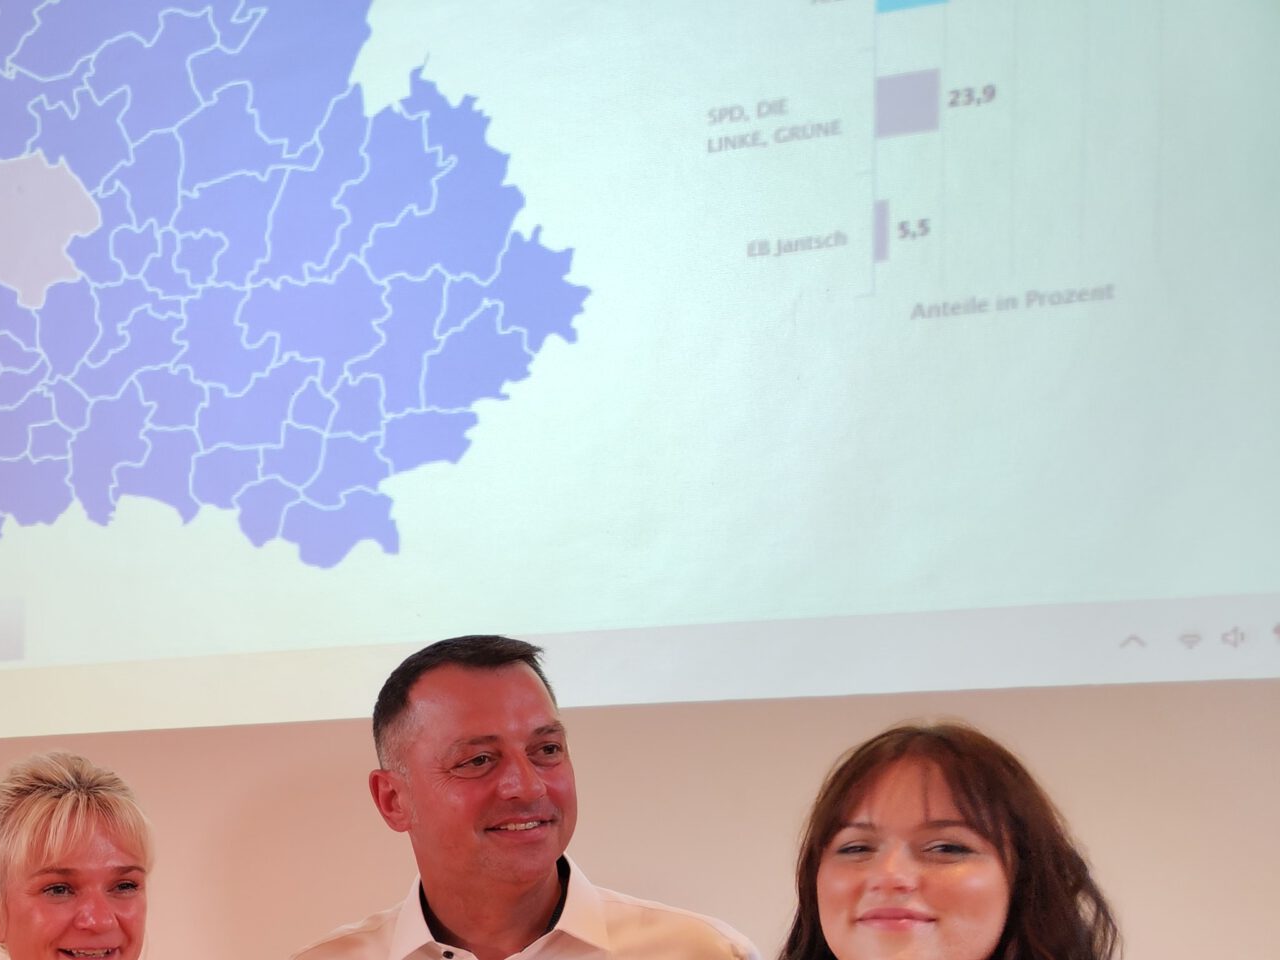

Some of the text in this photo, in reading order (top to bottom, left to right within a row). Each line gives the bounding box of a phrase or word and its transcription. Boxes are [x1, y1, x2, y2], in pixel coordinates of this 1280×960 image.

[948, 84, 996, 108] 23,9
[898, 219, 931, 240] 5,5
[910, 283, 1116, 321] Anteile in Prozent
